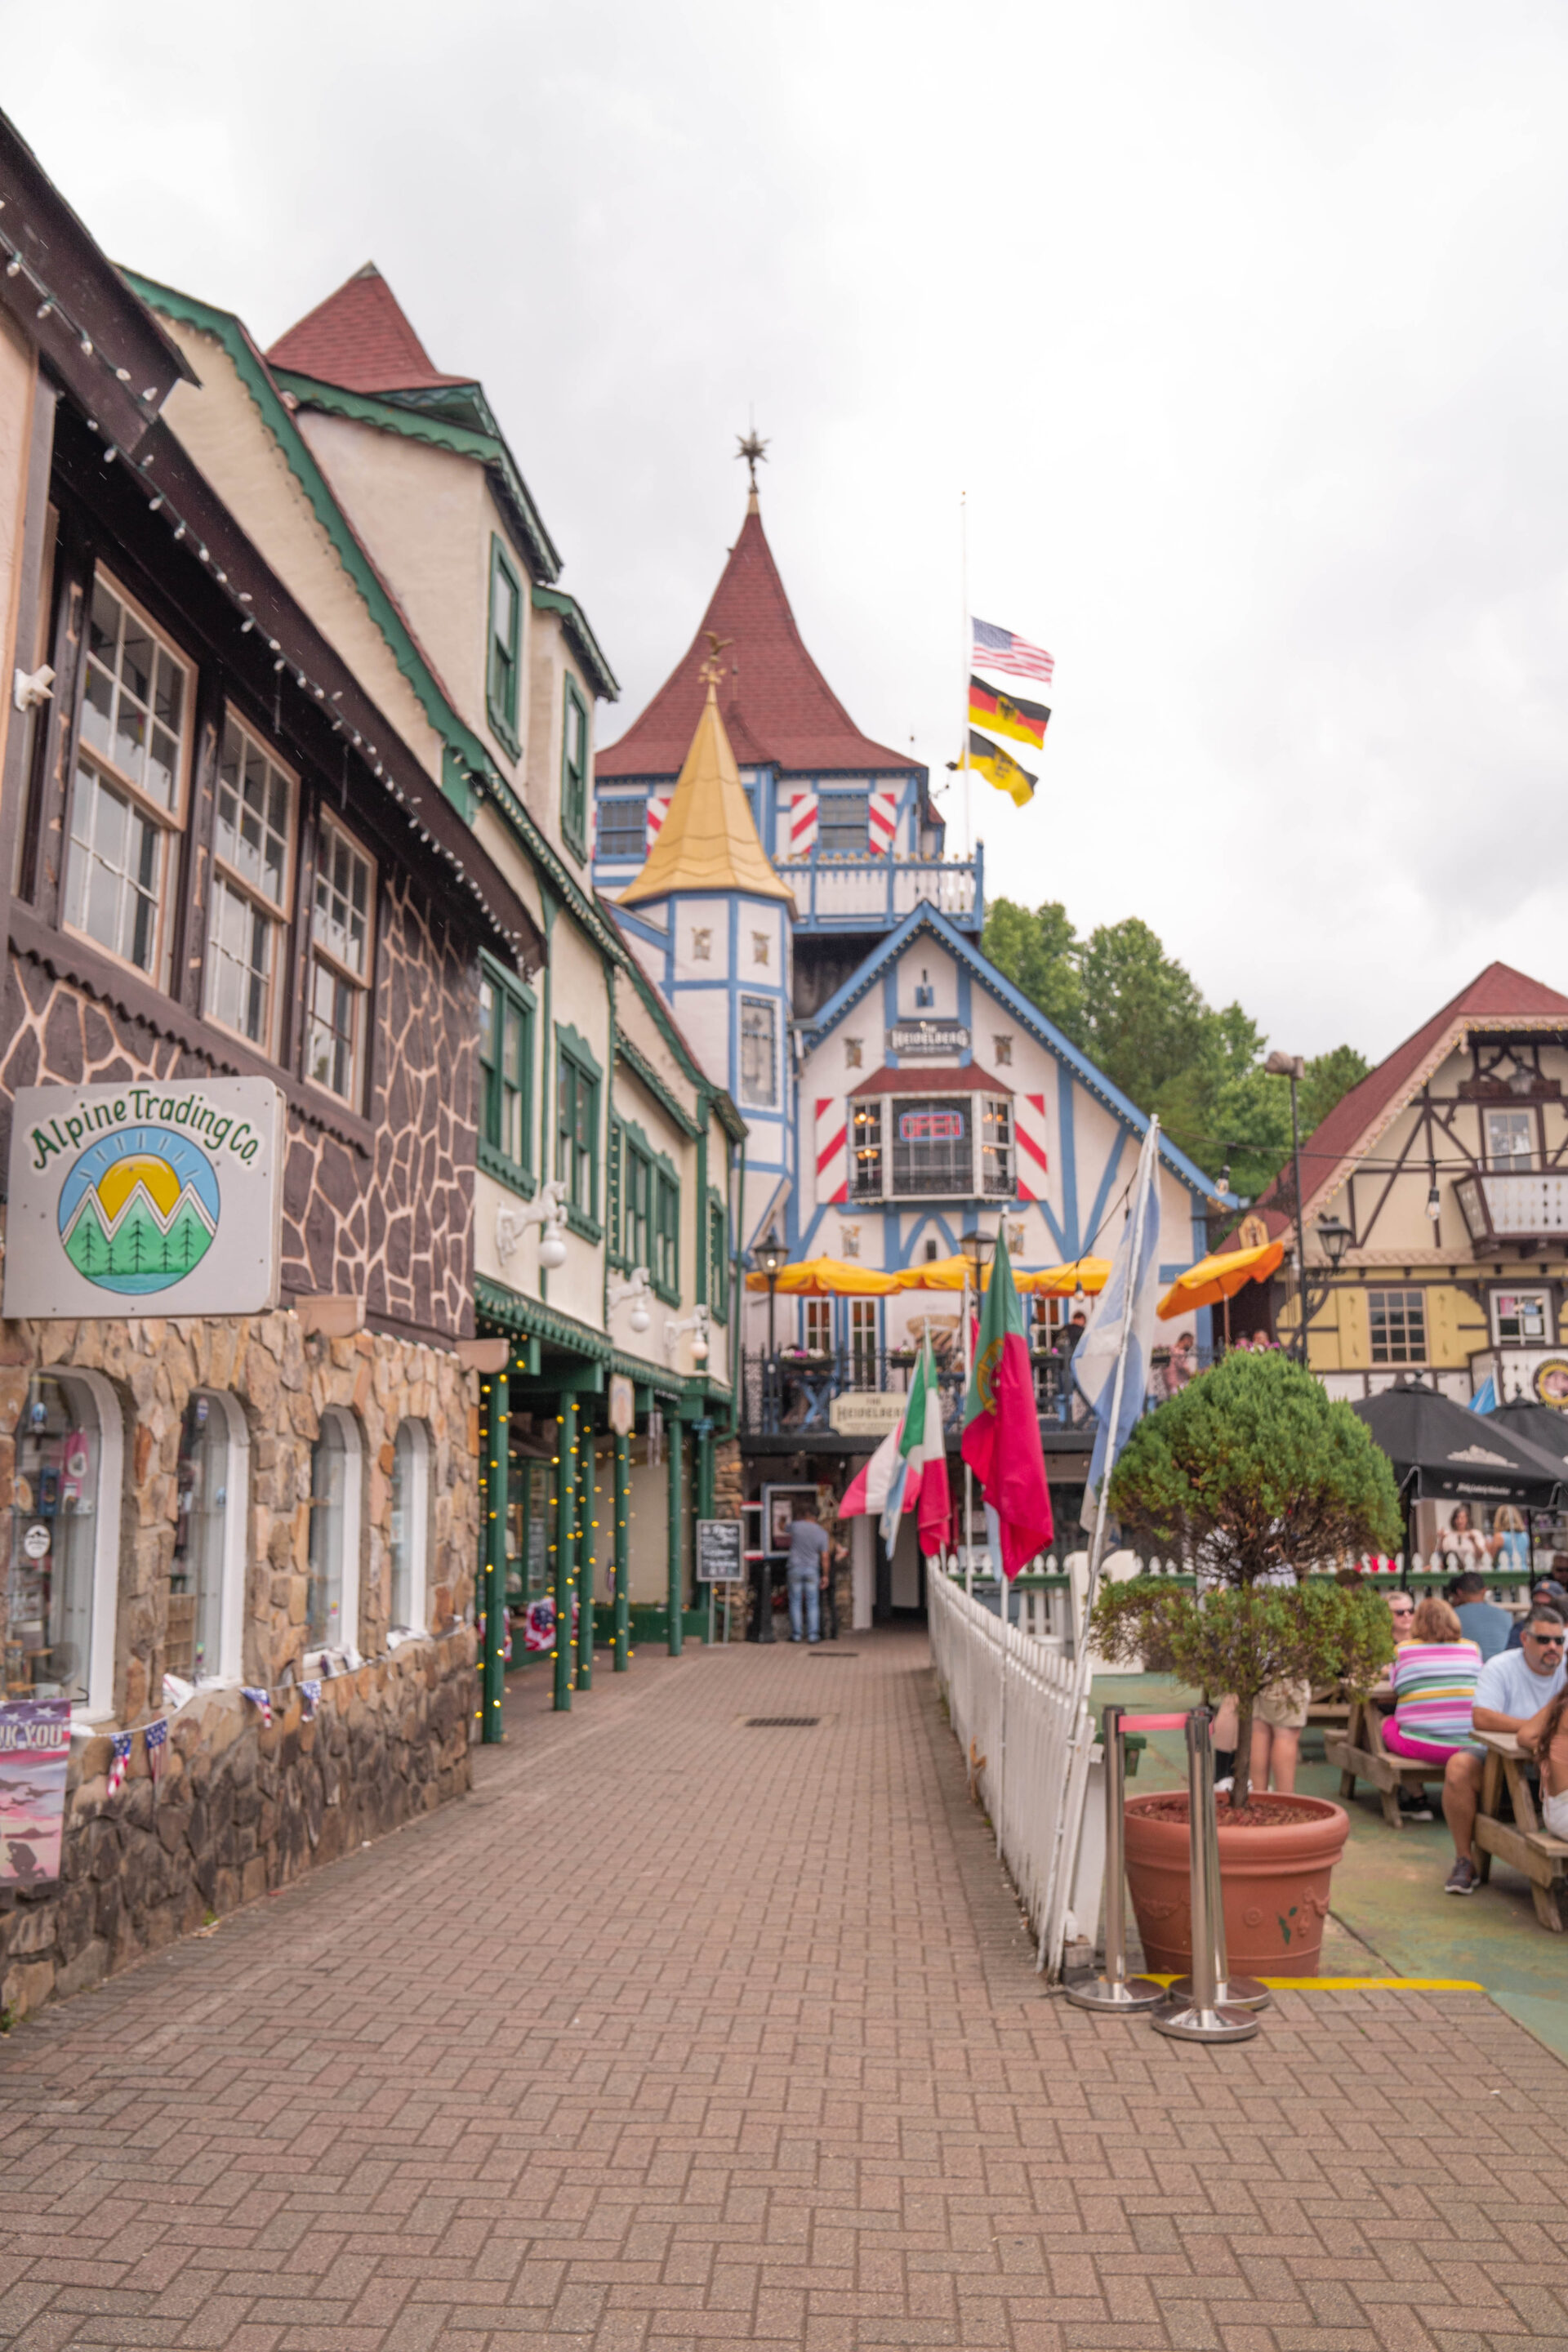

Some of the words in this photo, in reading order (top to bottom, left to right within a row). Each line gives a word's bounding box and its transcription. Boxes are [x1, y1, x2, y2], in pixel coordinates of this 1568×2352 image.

[892, 1029, 968, 1049] HEIDELBERG
[31, 1099, 127, 1169] Alpine
[128, 1089, 234, 1150] Trading
[229, 1122, 258, 1165] Co.
[902, 1114, 961, 1139] OPEN
[24, 1723, 63, 1748] YOU
